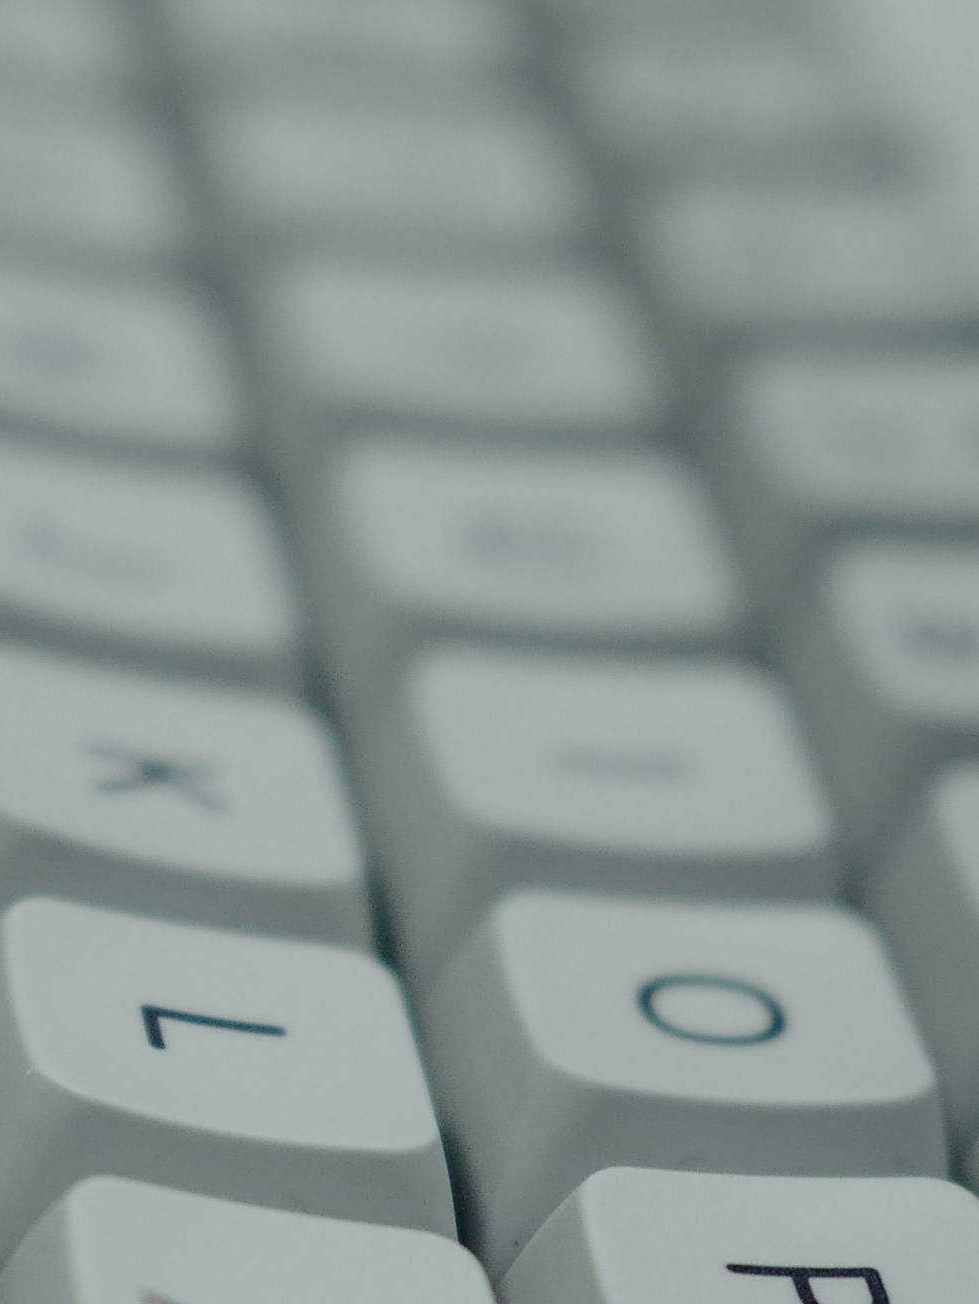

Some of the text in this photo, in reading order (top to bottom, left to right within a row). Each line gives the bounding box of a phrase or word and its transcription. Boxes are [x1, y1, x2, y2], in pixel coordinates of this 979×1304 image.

[87, 737, 225, 814] K
[139, 1003, 286, 1050] L
[635, 974, 786, 1047] O
